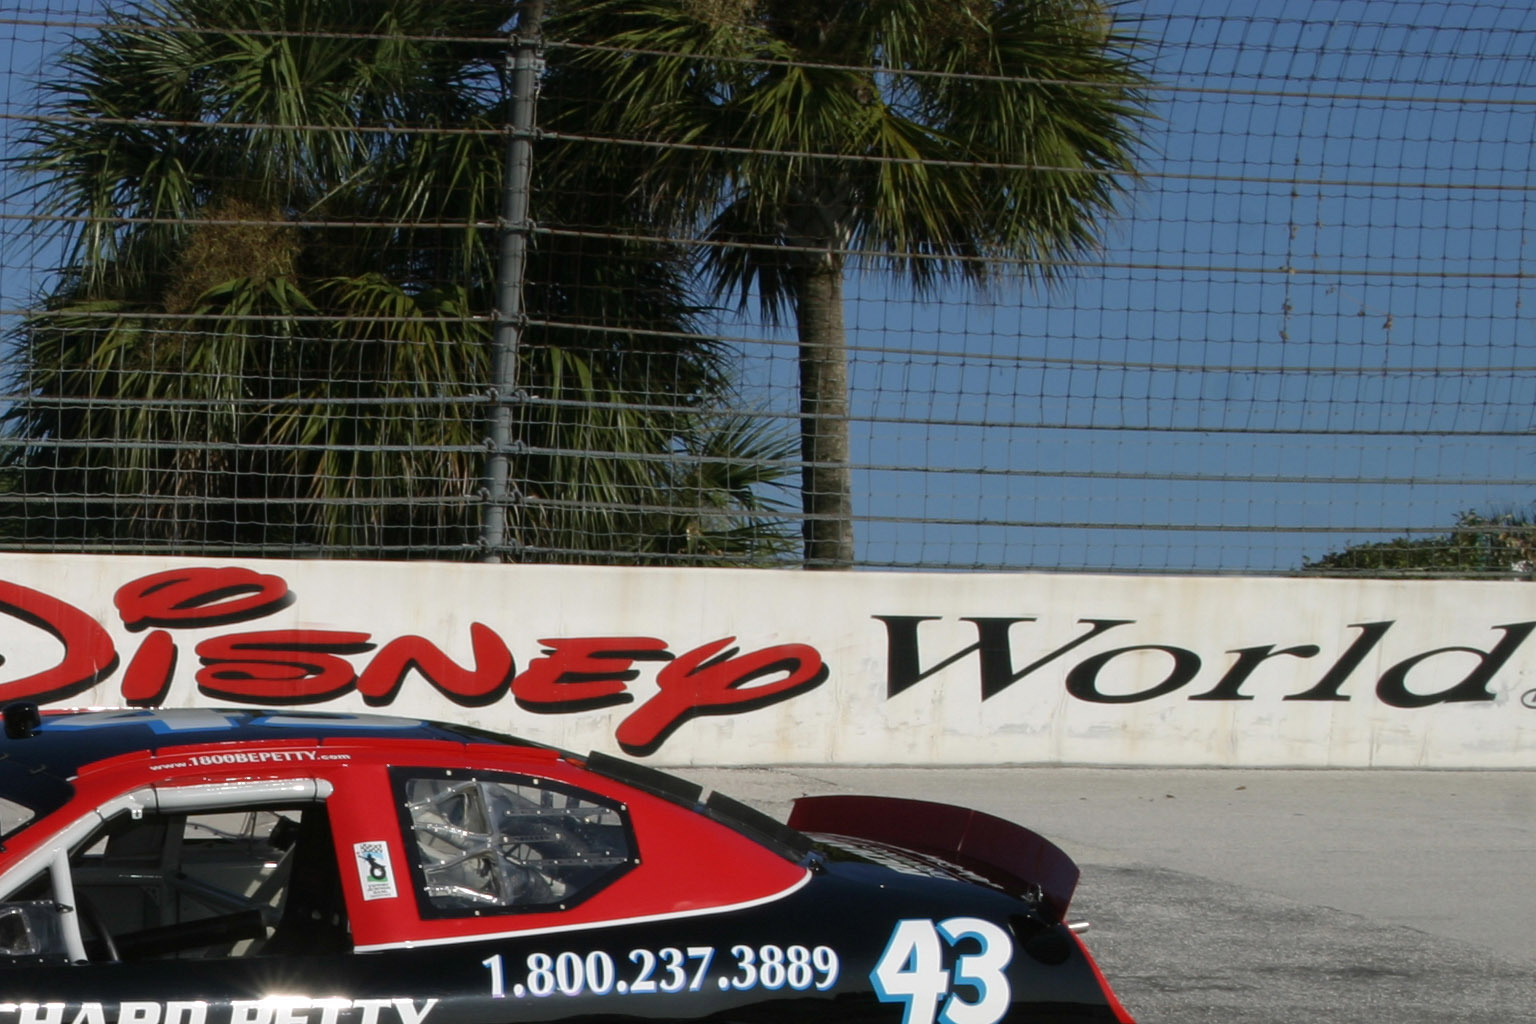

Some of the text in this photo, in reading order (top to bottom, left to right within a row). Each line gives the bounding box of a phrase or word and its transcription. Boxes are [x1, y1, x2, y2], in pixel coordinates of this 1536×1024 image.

[870, 613, 1536, 709] World
[149, 750, 351, 771] www.1800BEPETTY.com
[482, 944, 840, 998] 1.800.237.3889
